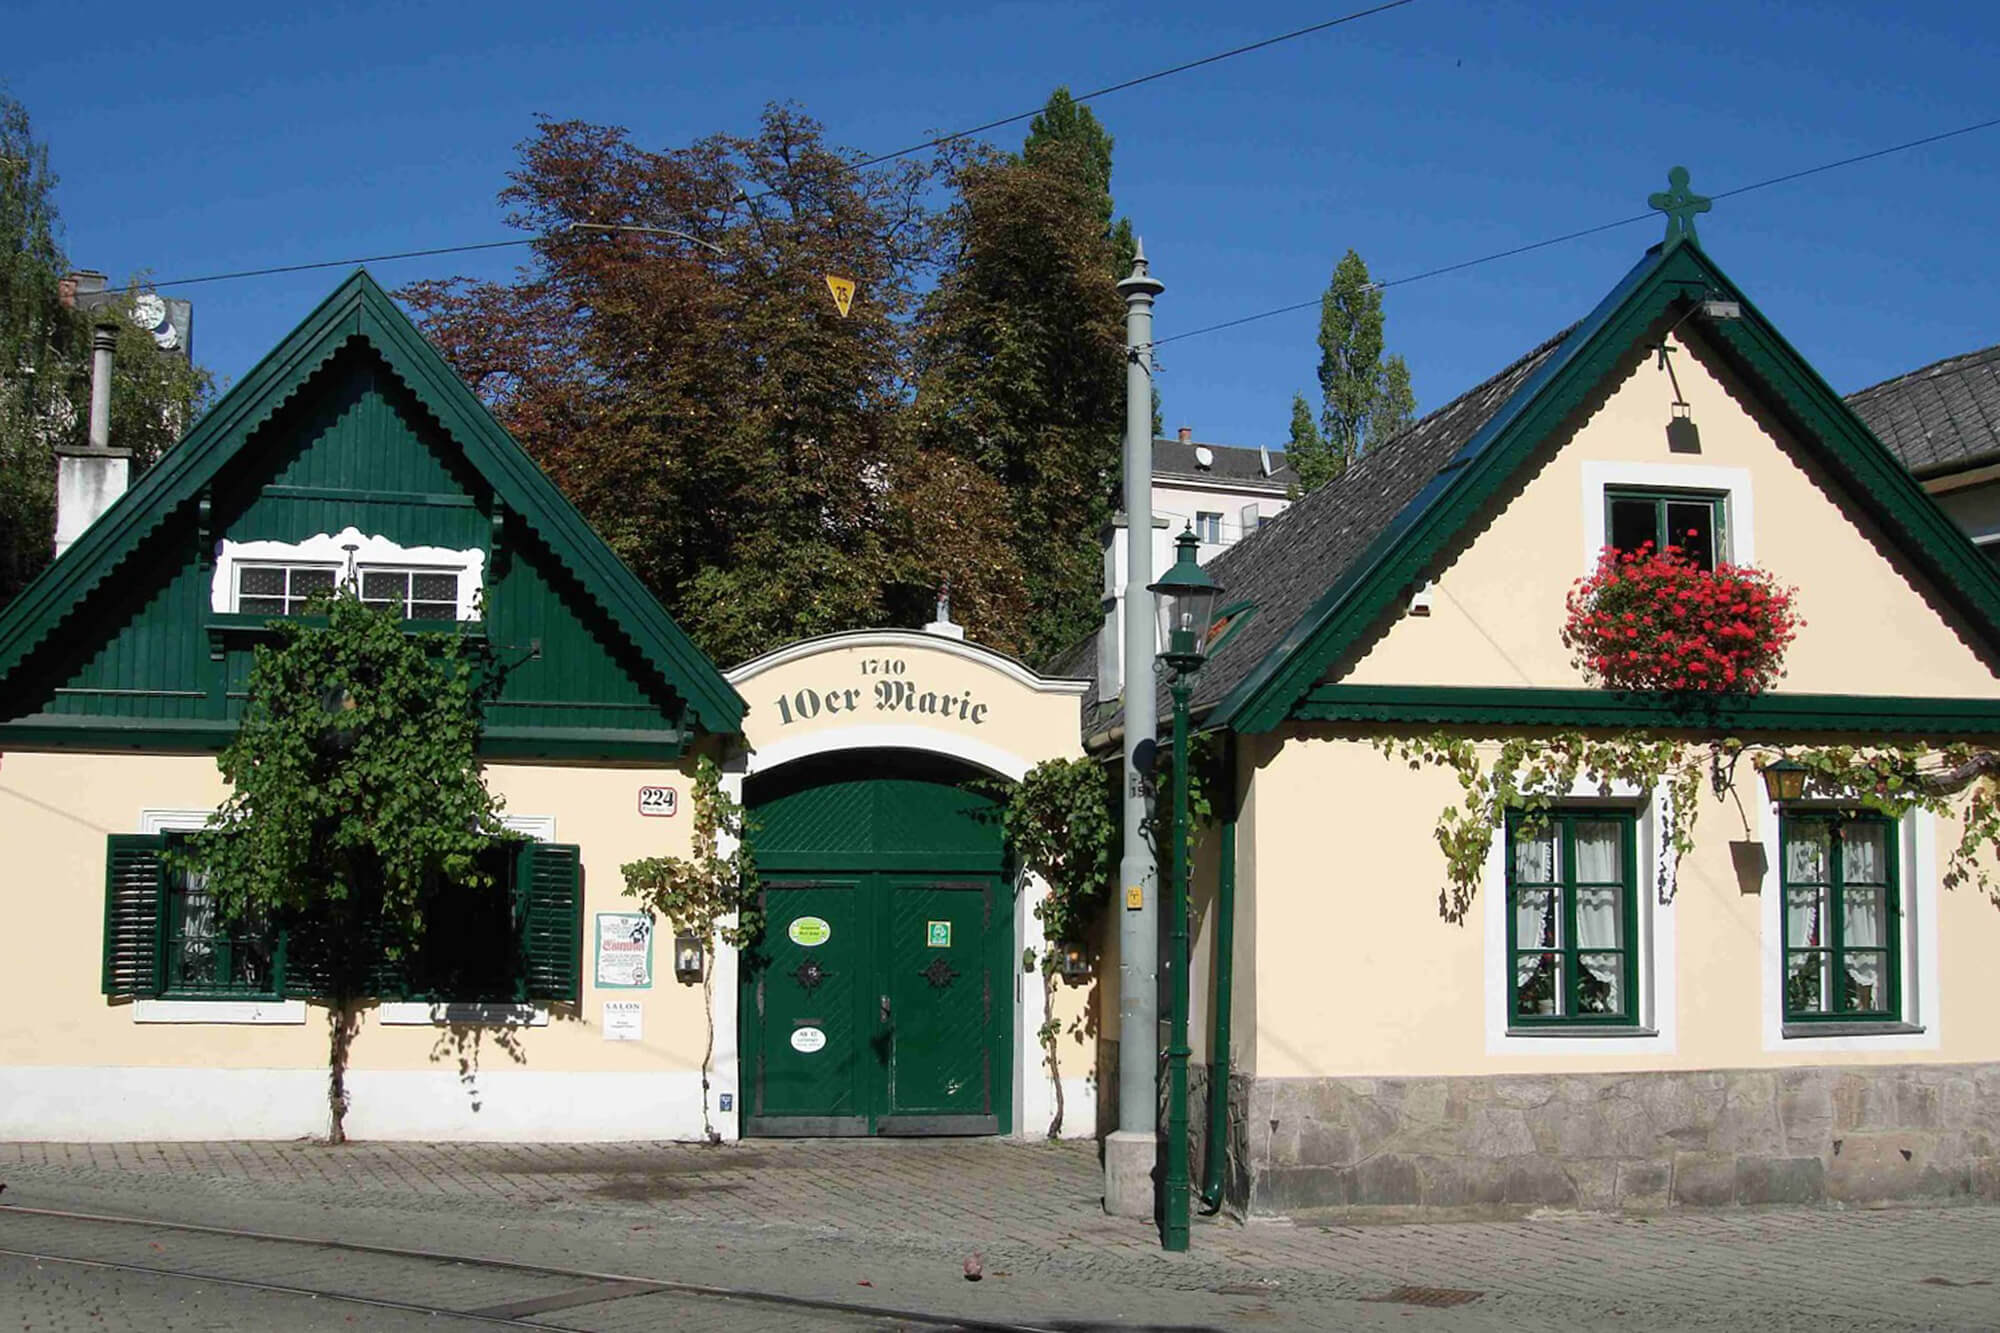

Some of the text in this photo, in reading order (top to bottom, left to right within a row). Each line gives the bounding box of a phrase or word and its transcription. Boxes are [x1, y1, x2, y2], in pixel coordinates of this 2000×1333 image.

[860, 659, 906, 675] 1740
[774, 680, 988, 725] 10er Marie
[642, 789, 674, 807] 224
